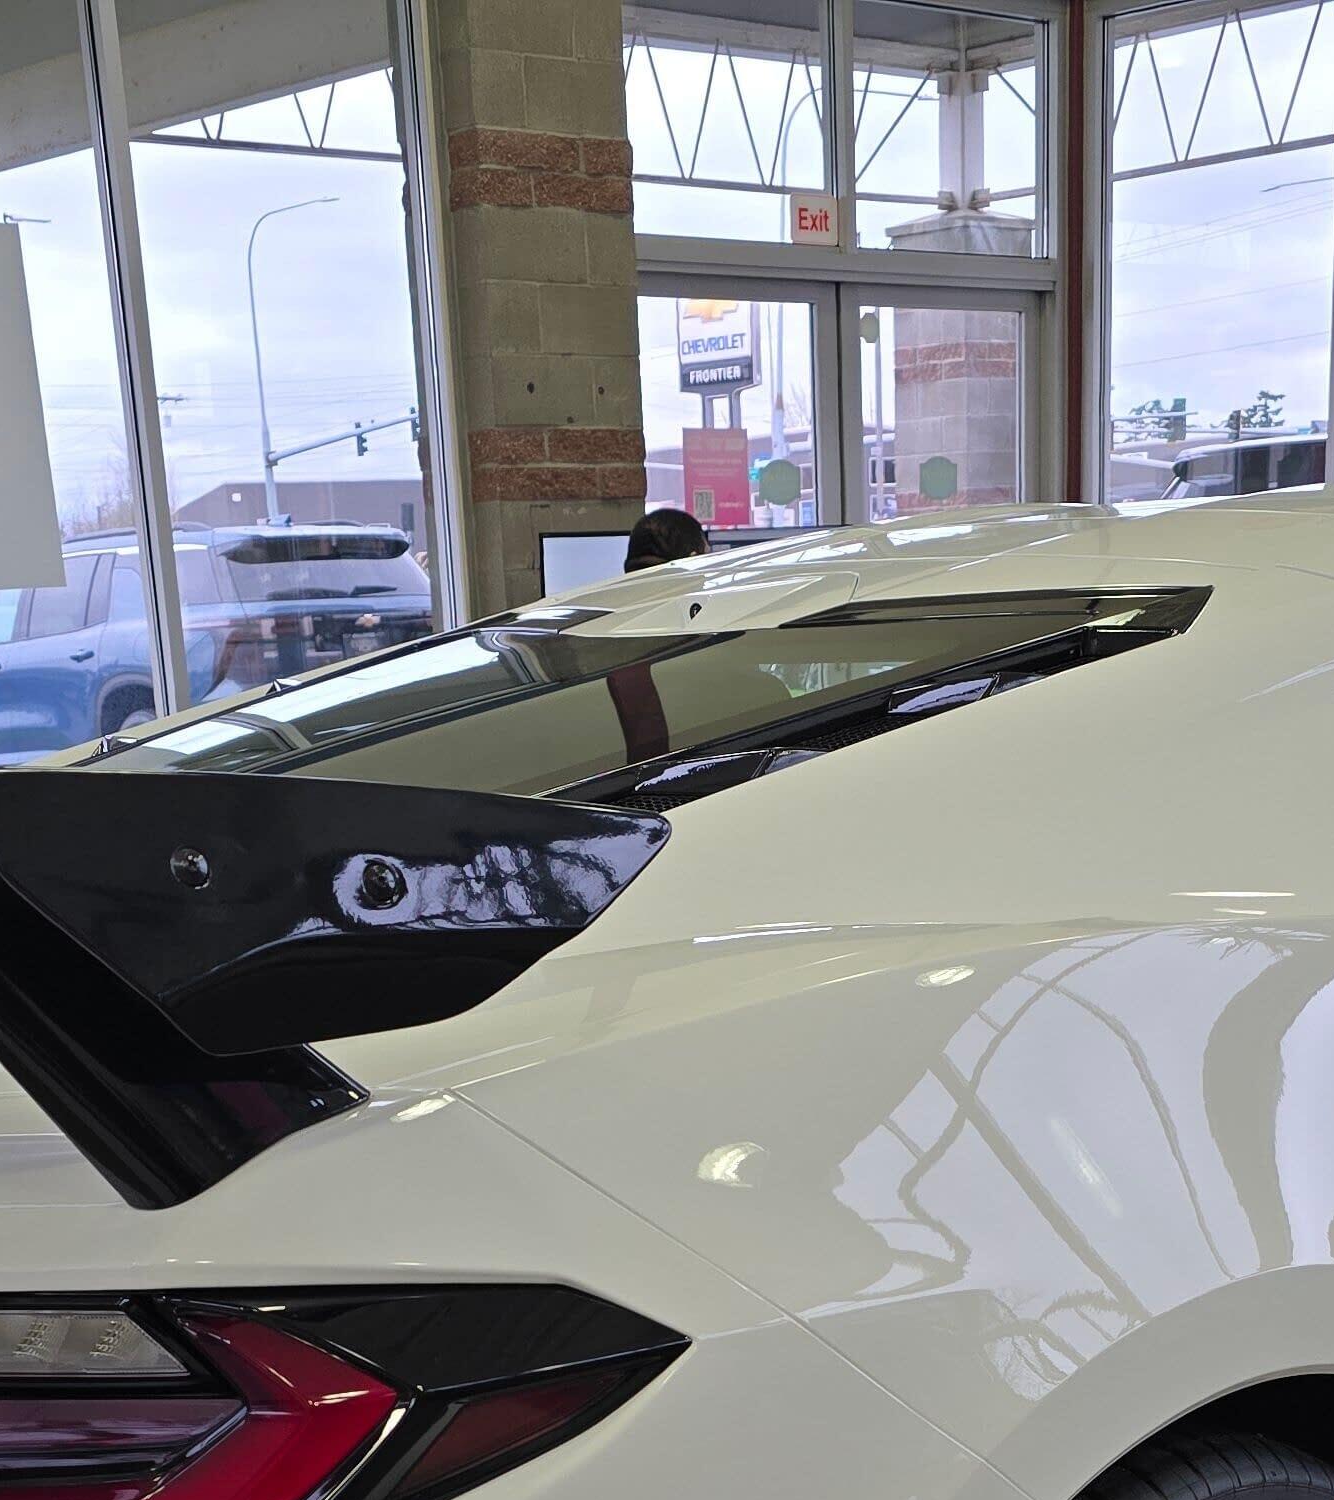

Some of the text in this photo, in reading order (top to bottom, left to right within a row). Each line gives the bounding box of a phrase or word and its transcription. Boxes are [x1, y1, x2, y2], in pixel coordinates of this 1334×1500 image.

[798, 207, 830, 232] Exit
[681, 333, 746, 355] CHEVROLET
[689, 365, 741, 385] FRONTIER
